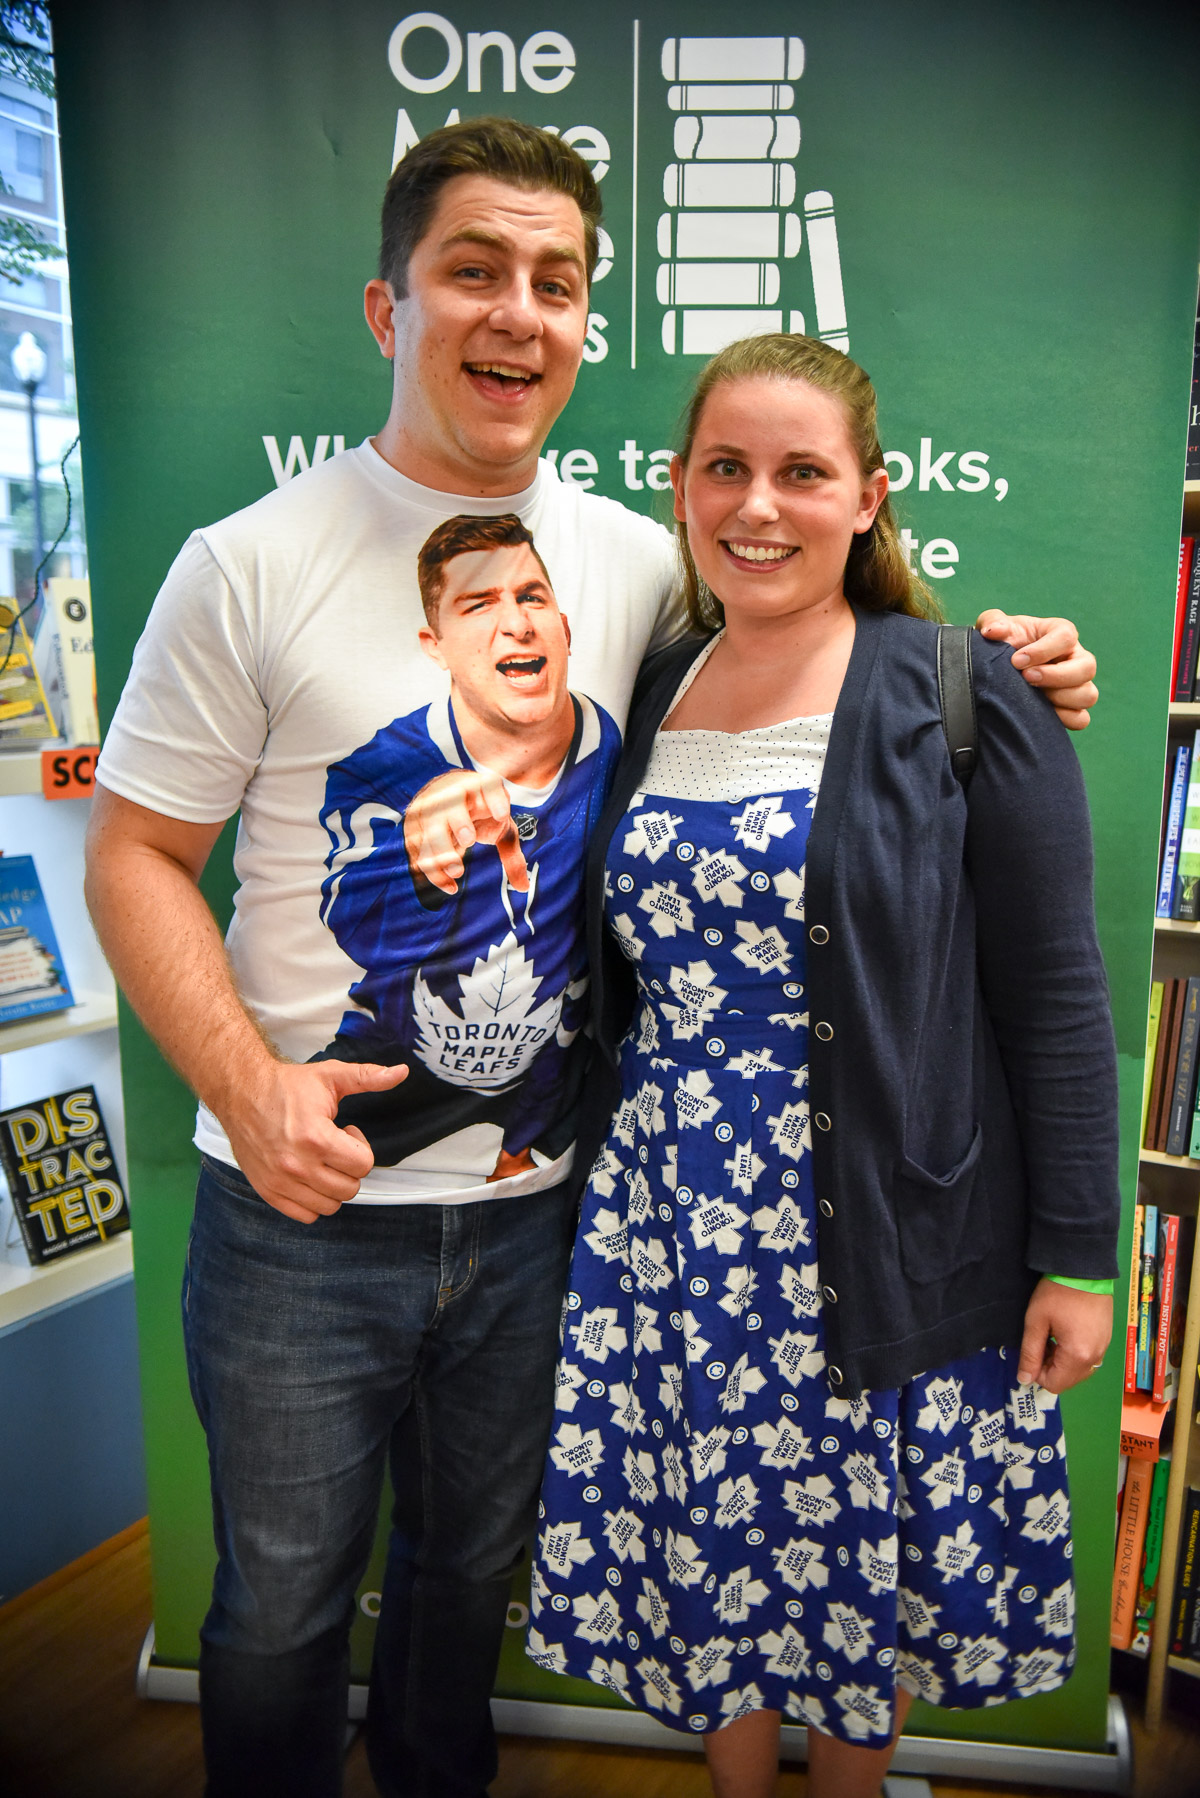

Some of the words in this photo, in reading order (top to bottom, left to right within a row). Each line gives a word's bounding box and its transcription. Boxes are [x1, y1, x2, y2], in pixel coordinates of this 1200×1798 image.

[387, 12, 577, 94] One
[618, 439, 676, 491] ta
[881, 437, 1009, 502] oks,
[1189, 599, 1198, 625] RAGE
[52, 756, 99, 788] SC
[658, 818, 669, 836] LEAFS
[744, 812, 754, 832] LEAFS
[750, 810, 762, 833] MAPLE
[756, 807, 771, 840] TORONTO
[642, 820, 657, 849] TORONTO
[701, 858, 721, 873] LEAFS
[705, 864, 726, 881] MAPLE
[704, 867, 735, 891] TORONTO
[657, 898, 680, 912] MAPLE
[660, 891, 681, 905] LEAFS
[649, 900, 684, 922] TORONTO
[746, 936, 776, 956] TORONTO
[762, 951, 782, 965] LEAFS
[679, 978, 714, 998] TORONTO
[681, 987, 706, 1001] MAPLE
[683, 994, 702, 1008] LEAFS
[428, 1021, 547, 1043] TORONTO
[442, 1041, 527, 1059] MAPLE
[439, 1054, 520, 1074] LEAFS
[677, 1095, 699, 1112] MAPLE
[678, 1090, 709, 1109] ORONTO
[7, 1092, 100, 1158] DIS
[619, 1109, 630, 1129] LEAFS
[780, 1114, 792, 1137] LEAFS
[787, 1116, 800, 1140] MAPLE
[791, 1114, 809, 1148] TORONTO
[18, 1140, 113, 1194] TRAC
[739, 1154, 747, 1178] LEAFS
[628, 1181, 642, 1210] TORONTO
[25, 1179, 124, 1243] TED
[699, 1206, 720, 1220] LEAFS
[702, 1213, 725, 1228] MAPLE
[701, 1216, 735, 1237] TORONTO
[771, 1207, 791, 1240] TORONTO
[787, 1223, 799, 1242] LEAFS
[637, 1250, 666, 1276] TORONTO
[638, 1259, 658, 1278] MAPLE
[636, 1266, 654, 1283] LEAFS
[791, 1293, 812, 1310] LEAFS
[792, 1286, 816, 1304] MAPLE
[1160, 1304, 1169, 1337] INSTANT
[583, 1321, 592, 1342] LEAFS
[589, 1321, 599, 1344] MAPLE
[594, 1318, 608, 1352] TORONTO
[1139, 1317, 1148, 1351] COOKBOOK
[780, 1340, 792, 1360] LEAFS
[1158, 1337, 1167, 1353] POT
[789, 1344, 807, 1374] TORONTO
[932, 1390, 949, 1421] TORONTO
[979, 1419, 1000, 1433] LEAFS
[560, 1440, 593, 1458] TORONTO
[697, 1436, 713, 1454] LEAFS
[771, 1428, 790, 1460] TORONTO
[781, 1437, 794, 1459] MAPLE
[788, 1442, 801, 1460] LEAFS
[1120, 1434, 1155, 1450] STANT
[1120, 1444, 1136, 1455] OT
[568, 1448, 590, 1464] MAPLE
[573, 1455, 593, 1468] LEAFS
[631, 1459, 652, 1491] TORONTO
[850, 1467, 877, 1496] TORONTO
[934, 1473, 958, 1486] TORONTO
[721, 1485, 745, 1516] TORONTO
[726, 1494, 745, 1515] MAPLE
[731, 1501, 749, 1518] LEAFS
[794, 1490, 831, 1509] TORONTO
[795, 1503, 818, 1517] LEAFS
[796, 1497, 822, 1512] MAPLE
[1032, 1502, 1059, 1530] TORONTO
[1041, 1511, 1060, 1531] MAPLE
[1048, 1516, 1064, 1534] LEAFS
[1126, 1496, 1140, 1535] LITTLE
[546, 1534, 556, 1556] LEAFS
[619, 1525, 636, 1550] TORONTO
[1186, 1509, 1200, 1564] REINCARNATION
[553, 1536, 564, 1559] MAPLE
[559, 1532, 571, 1567] TORONTO
[947, 1546, 971, 1557] TORONTO
[1121, 1538, 1134, 1576] HOUSE
[790, 1550, 805, 1573] MAPLE
[794, 1551, 813, 1580] TORONTO
[869, 1565, 895, 1576] MAPLE
[945, 1561, 961, 1570] LEAFS
[869, 1570, 892, 1584] LEAFS
[1182, 1564, 1192, 1587] BLUES
[587, 1602, 610, 1631] TORONTO
[602, 1618, 617, 1635] LEAFS
[836, 1612, 854, 1651] TORONTO
[776, 1636, 795, 1666] TORONTO
